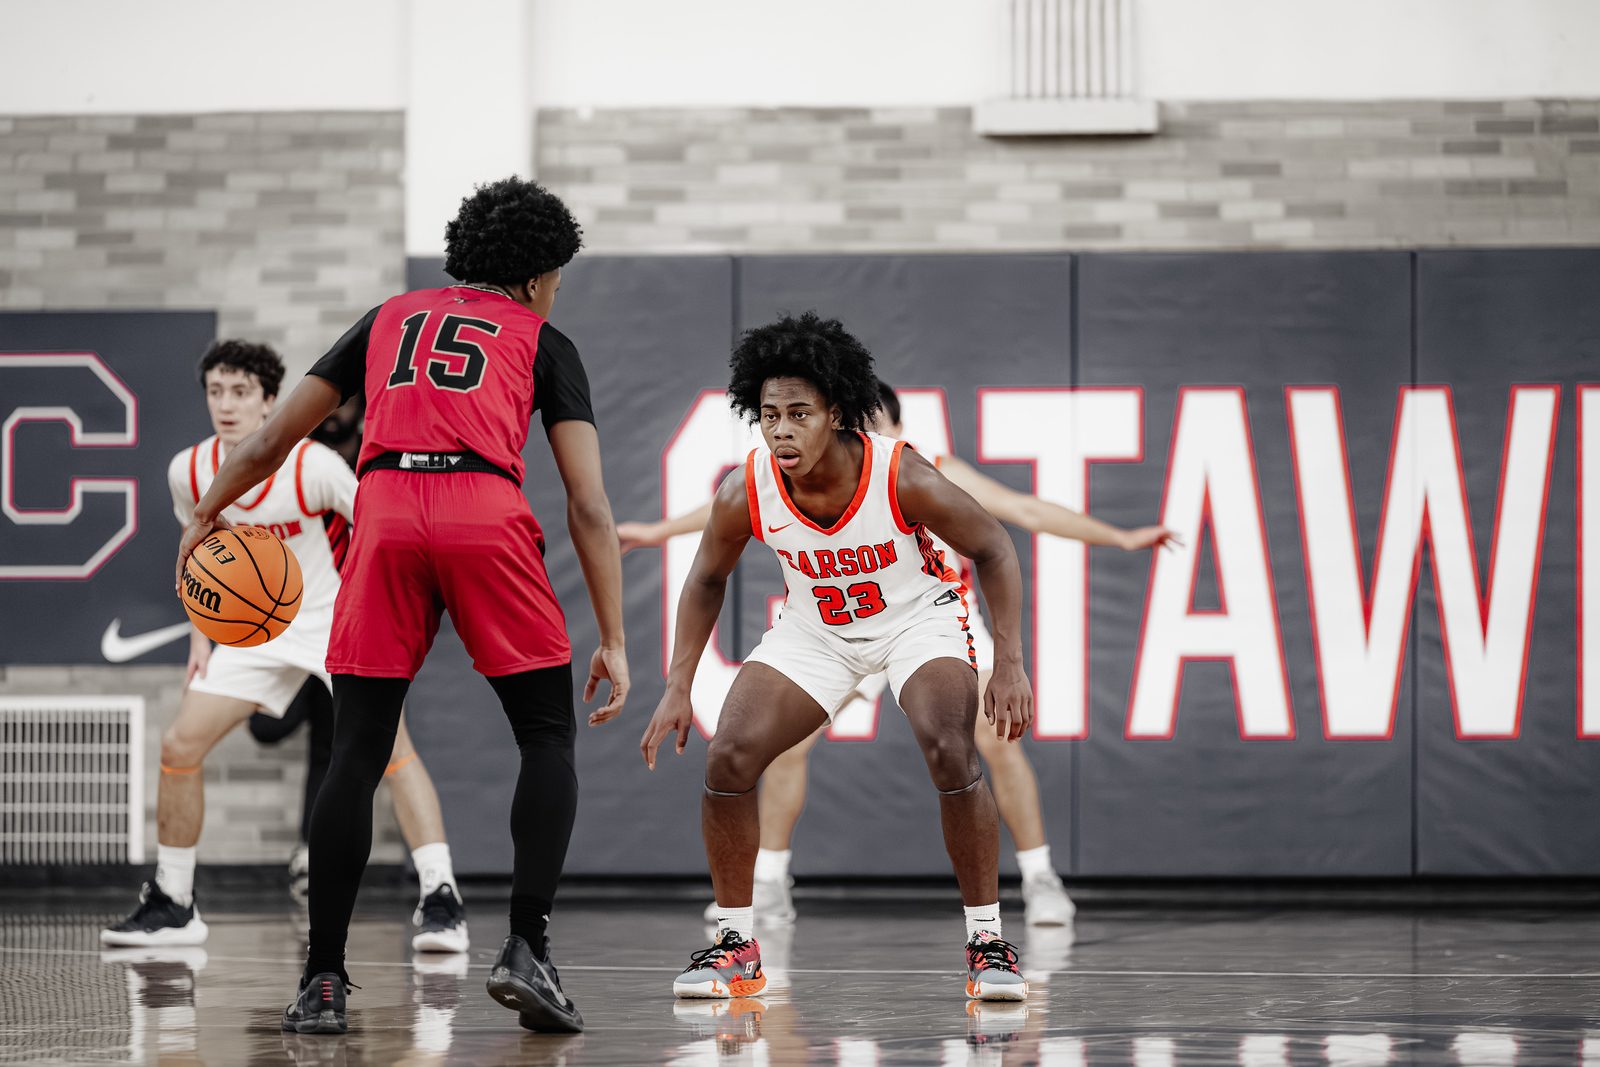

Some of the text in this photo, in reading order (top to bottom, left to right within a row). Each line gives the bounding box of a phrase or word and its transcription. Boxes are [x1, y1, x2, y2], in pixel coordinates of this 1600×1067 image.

[386, 310, 502, 393] 15
[663, 386, 1600, 741] CTAW
[812, 581, 887, 626] 23
